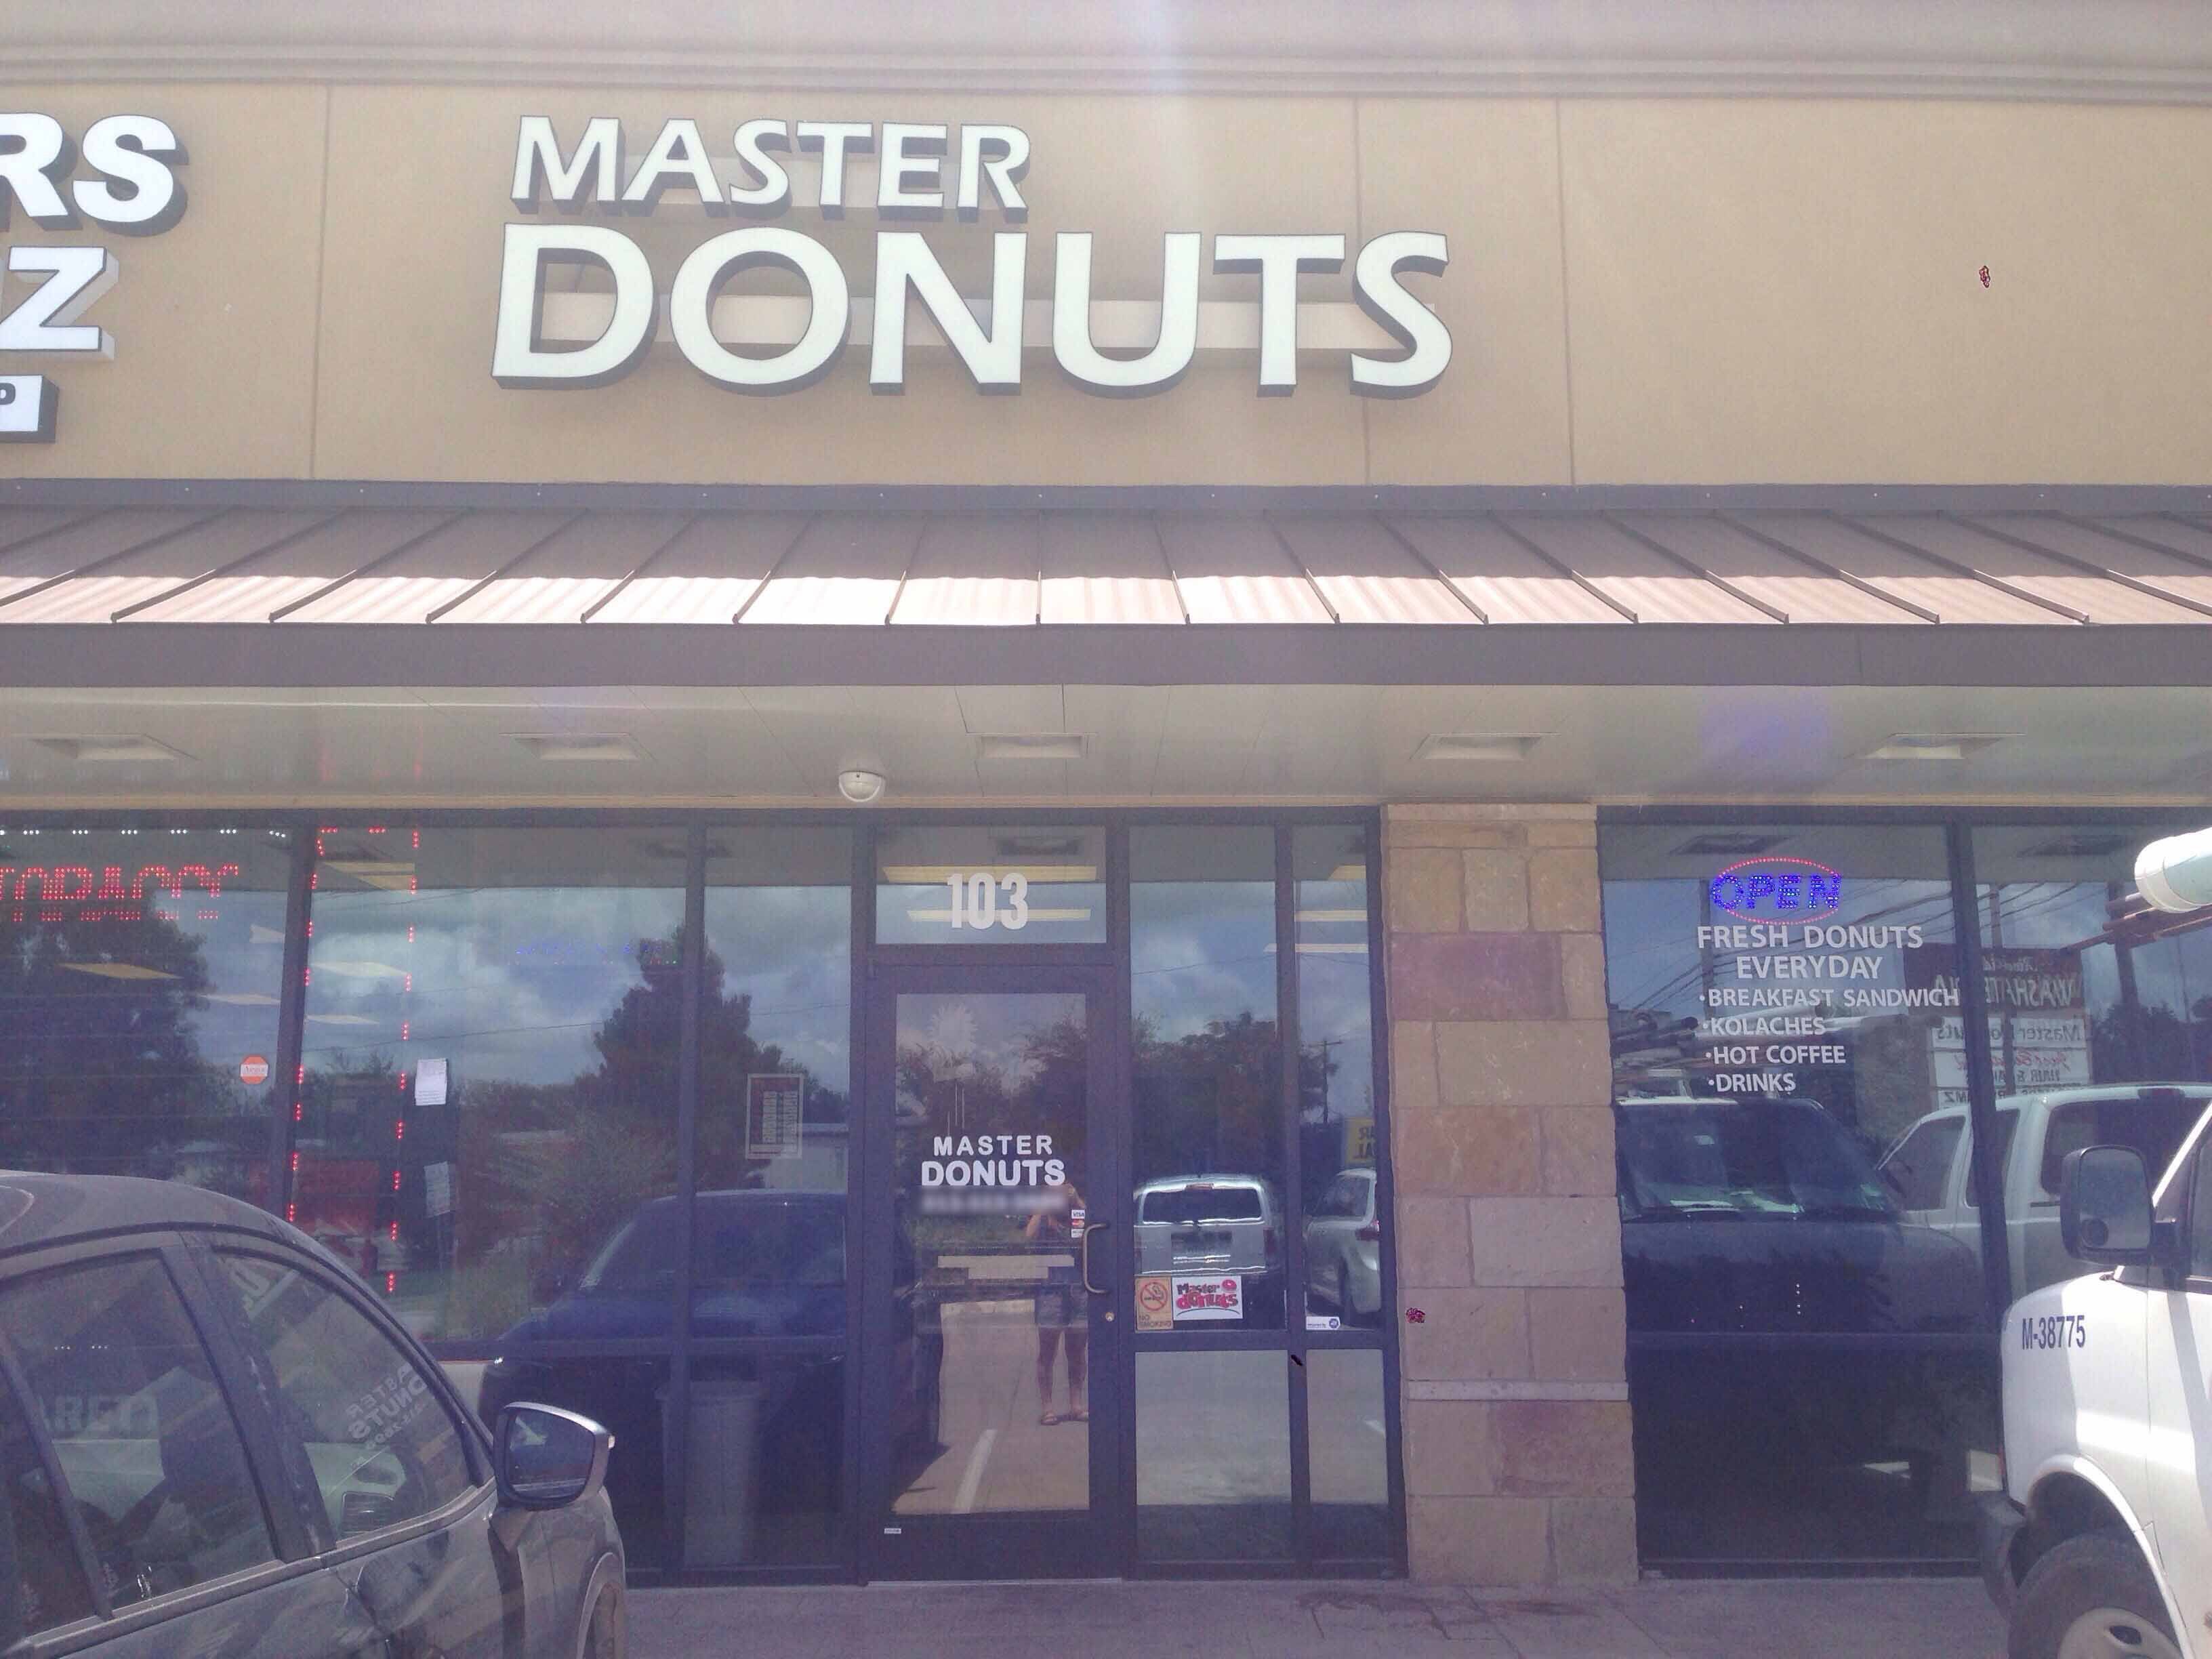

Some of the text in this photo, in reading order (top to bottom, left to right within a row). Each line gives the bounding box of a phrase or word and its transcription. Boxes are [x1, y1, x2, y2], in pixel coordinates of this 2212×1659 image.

[510, 115, 1031, 209] MASTER
[491, 222, 1453, 386] DONUTS
[947, 872, 1029, 930] 103
[1711, 874, 1841, 910] OPEN
[1697, 925, 1924, 949] FRESH DONUTS
[1736, 956, 1884, 979] EVERYDAY
[1708, 988, 1961, 1008] BREAKFAST SANDWICH
[1711, 1017, 1826, 1036] KOLACHES
[1713, 1044, 1847, 1065] HOT COFFEE
[1716, 1072, 1797, 1092] DRINKS
[933, 1135, 1052, 1156] MASTER
[921, 1159, 1065, 1187] DONUTS
[1176, 1292, 1238, 1309] donuts
[1177, 1283, 1220, 1295] Master
[2022, 1315, 2086, 1350] M-38775
